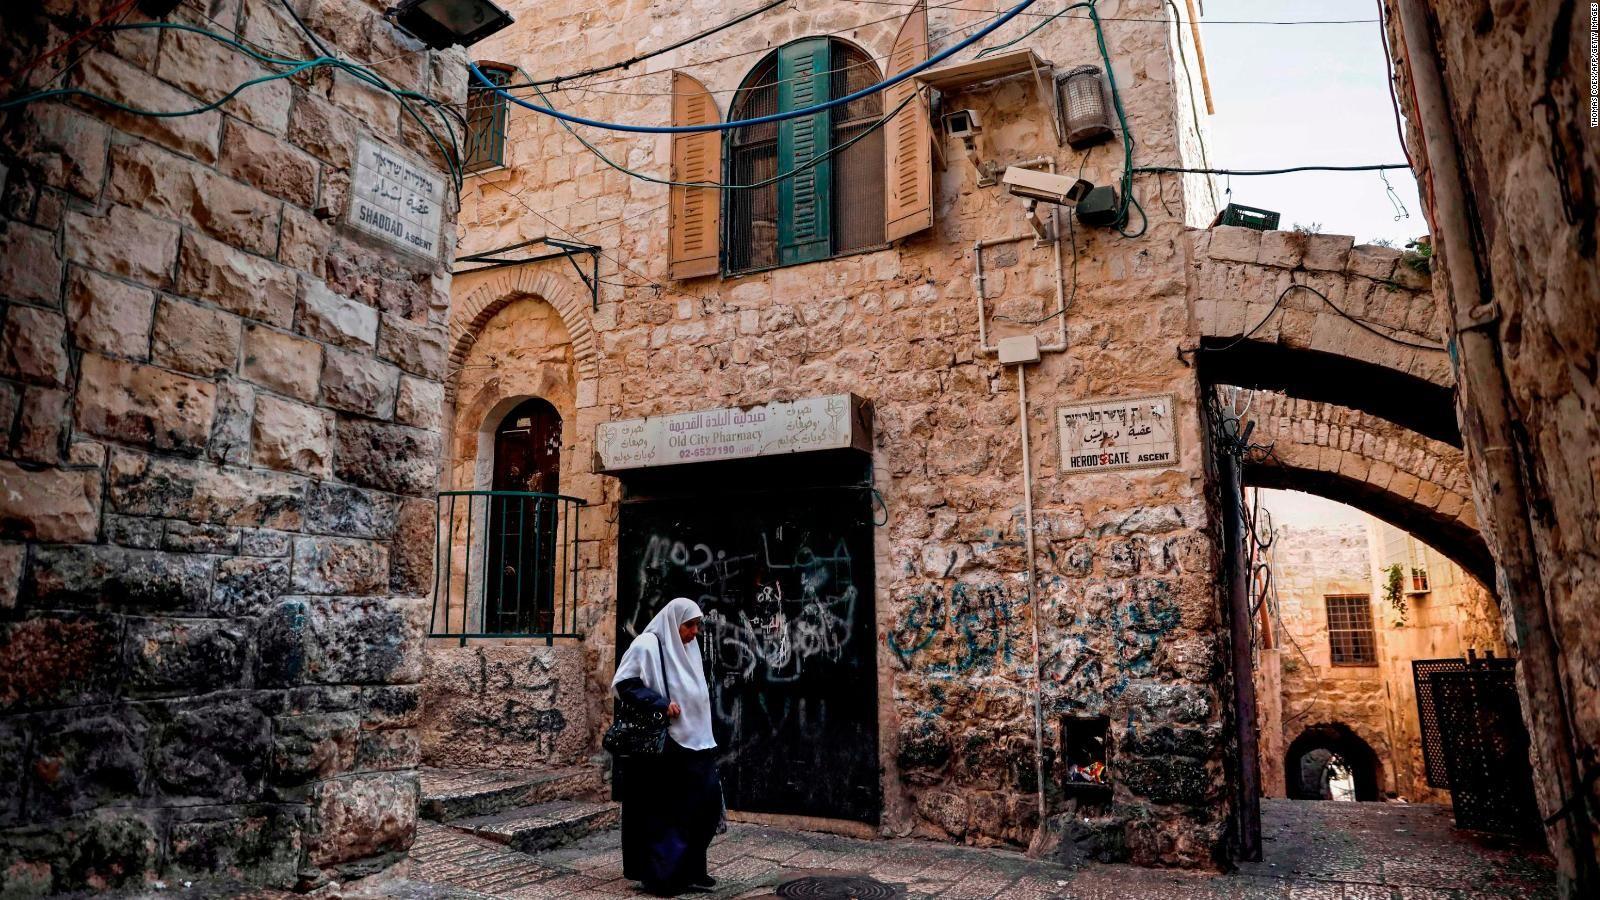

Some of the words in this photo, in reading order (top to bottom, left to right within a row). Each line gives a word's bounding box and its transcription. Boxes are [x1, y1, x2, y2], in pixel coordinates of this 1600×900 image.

[406, 193, 429, 215] عقبة
[359, 205, 404, 238] SHADDAD
[404, 231, 433, 251] ASCENT
[669, 414, 703, 434] القديمة
[705, 410, 731, 430] البلدة
[733, 412, 766, 427] صيدلية
[668, 434, 687, 448] Old
[689, 433, 710, 448] City
[712, 430, 764, 444] Pharmacy
[1083, 428, 1120, 443] درويش
[1127, 424, 1151, 440] عقبة
[1109, 451, 1130, 465] GATE
[1137, 452, 1170, 462] ASCENT
